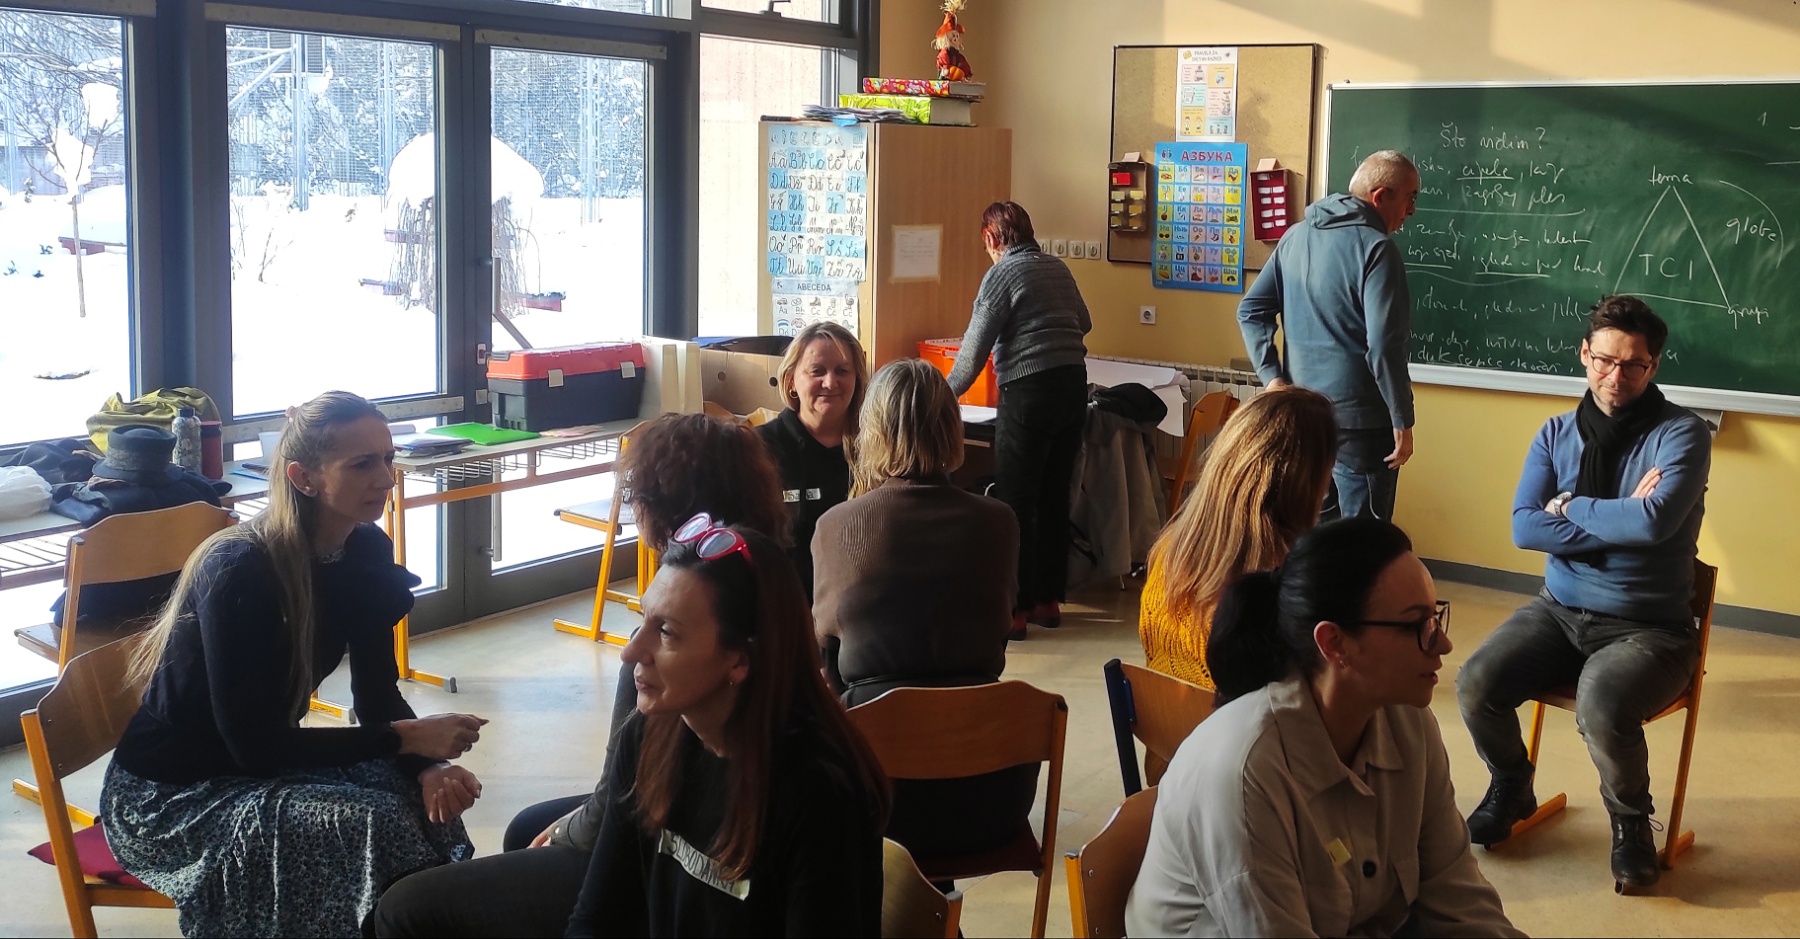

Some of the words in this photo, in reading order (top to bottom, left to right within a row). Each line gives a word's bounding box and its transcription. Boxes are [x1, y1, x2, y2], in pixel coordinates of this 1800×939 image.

[1440, 121, 1467, 148] Što
[1181, 151, 1233, 162] АЗБУКА
[1648, 165, 1694, 186] tema
[796, 283, 832, 292] ABECEDA
